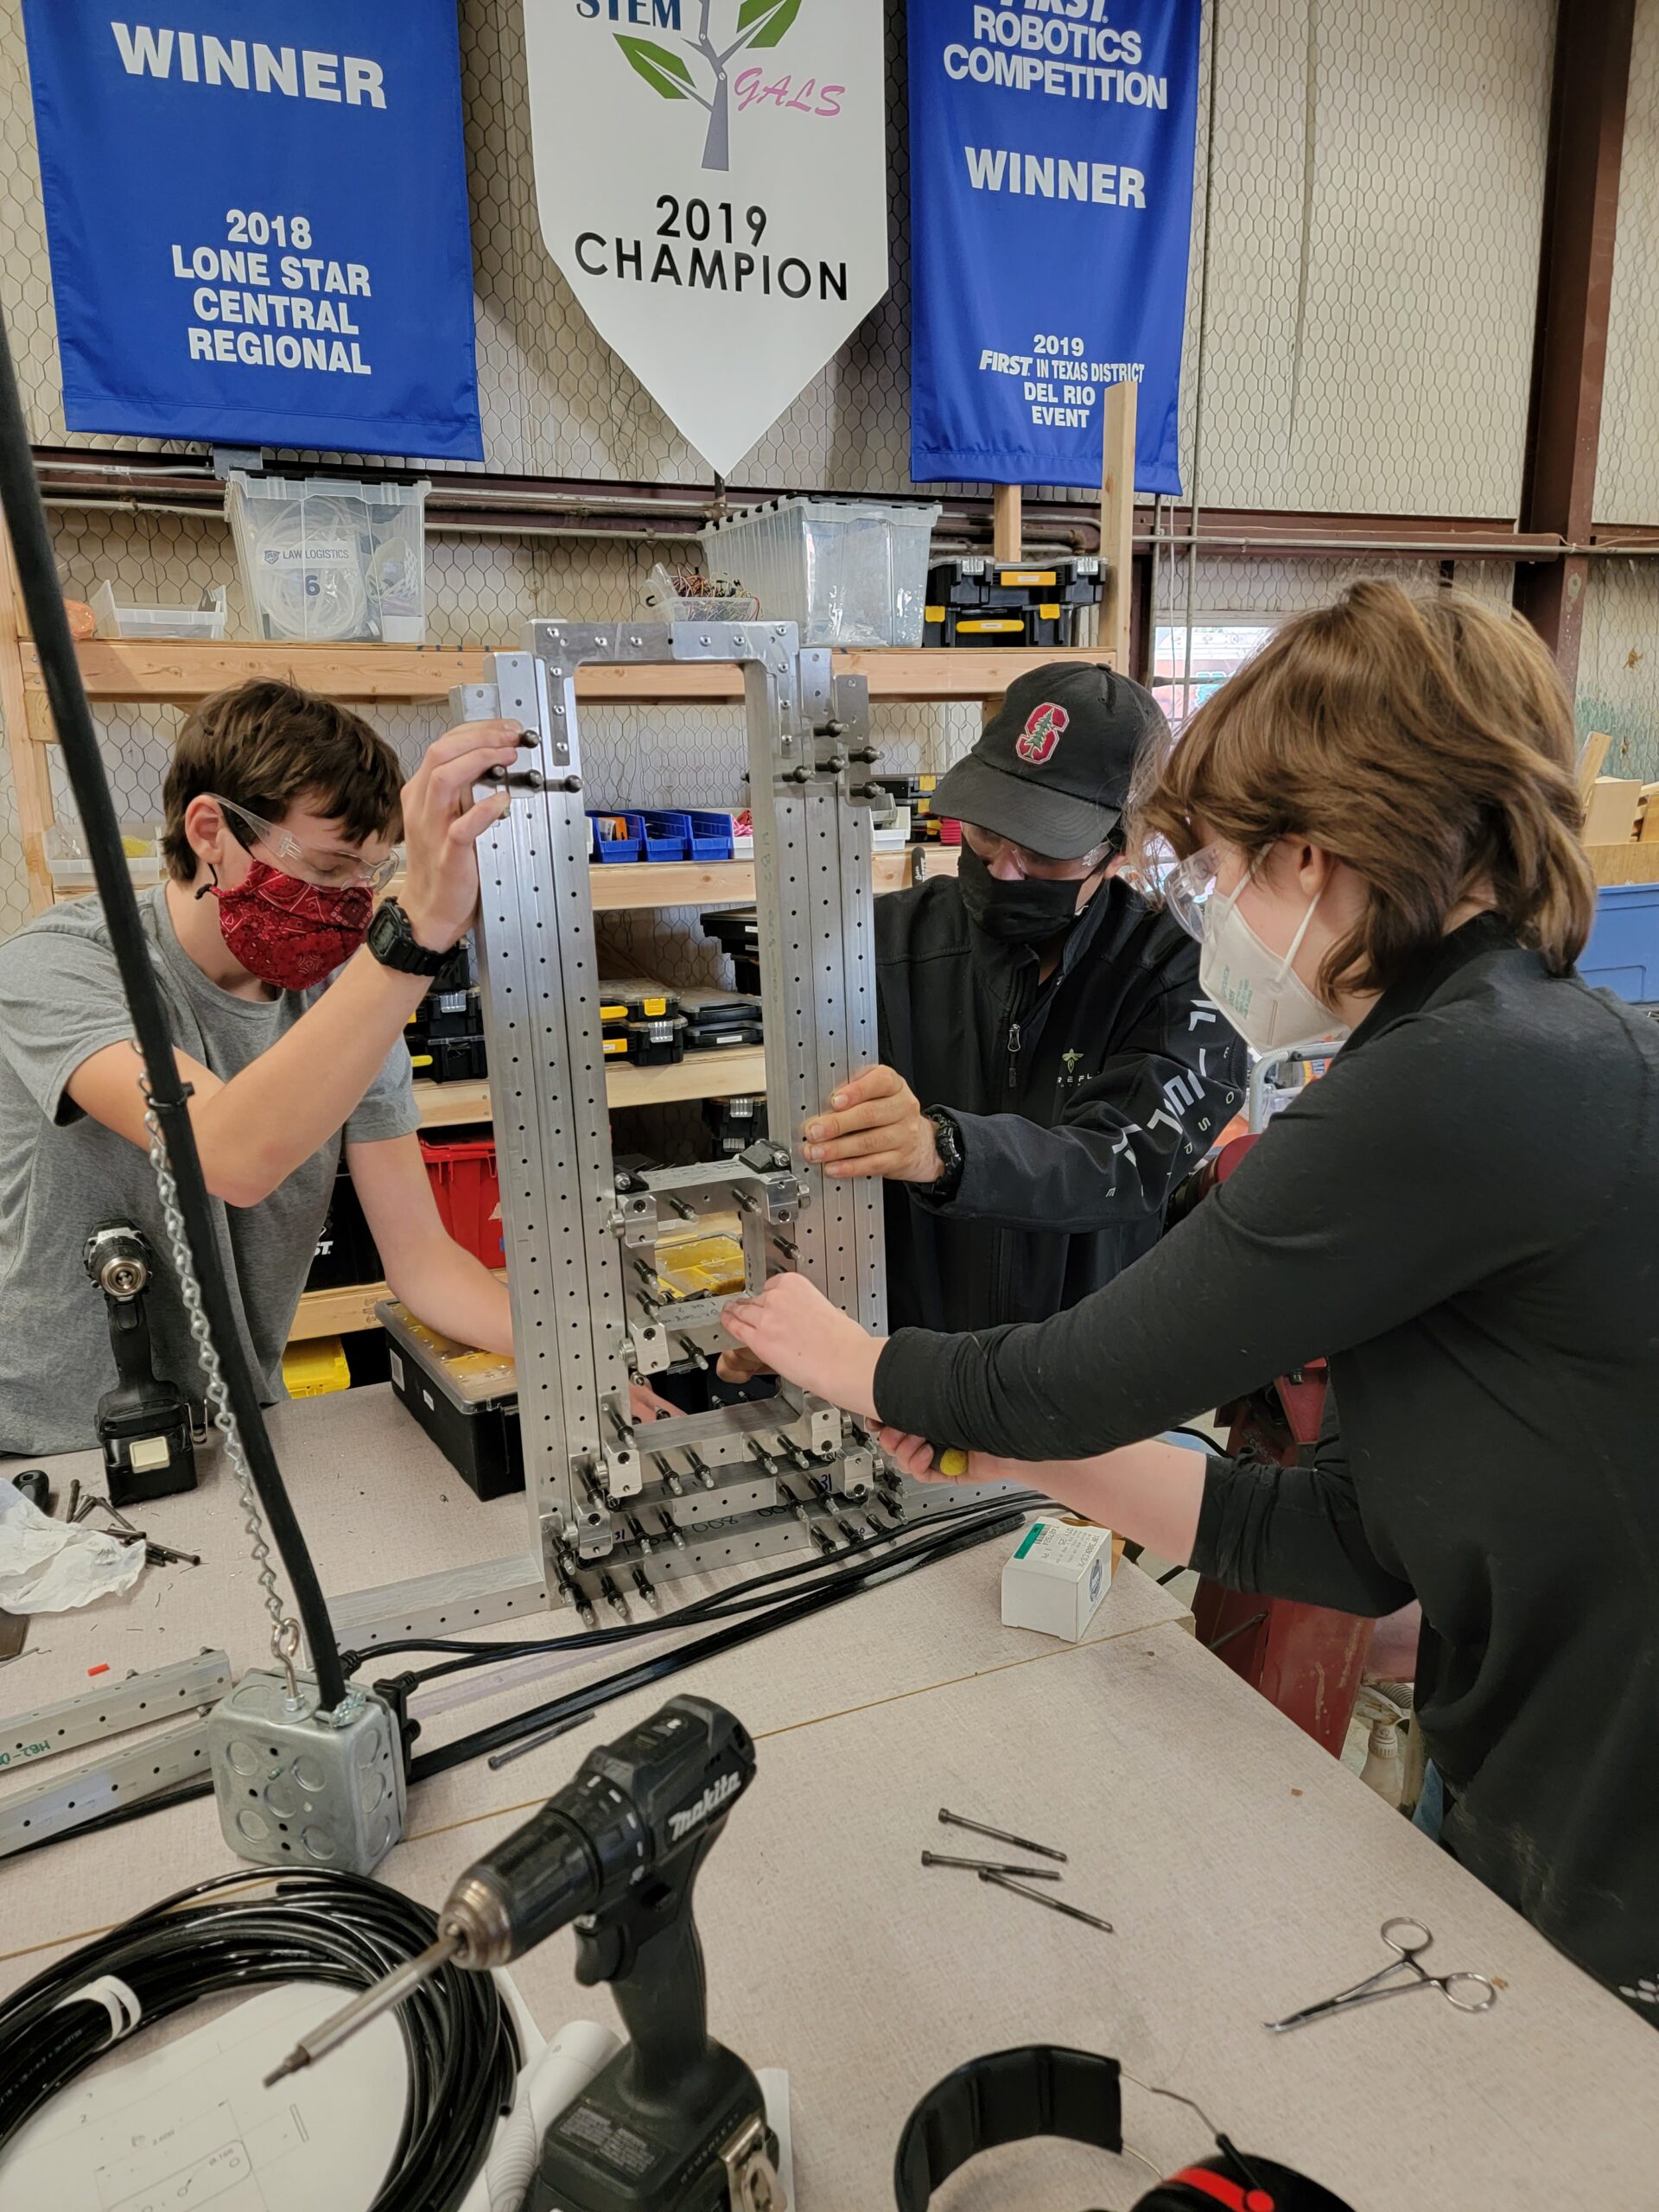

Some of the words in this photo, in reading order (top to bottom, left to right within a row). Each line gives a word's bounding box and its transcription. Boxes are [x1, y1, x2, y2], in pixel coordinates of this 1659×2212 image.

[974, 5, 1142, 65] ROBOTICS
[111, 22, 387, 109] WINNER
[944, 44, 1167, 110] COMPETITION
[734, 67, 845, 117] GALS
[964, 147, 1146, 208] WINNER
[226, 209, 312, 250] 2018
[656, 194, 766, 247] 2019
[172, 245, 270, 286] LONE
[281, 256, 372, 297] STAR
[575, 232, 848, 301] CHAMPION
[193, 288, 359, 335] CENTRAL
[188, 327, 372, 375] REGIONAL
[1033, 334, 1084, 356] 2019
[1024, 382, 1058, 403] DEL
[1064, 385, 1096, 406] RIO
[1037, 359, 1049, 378] IN
[1052, 360, 1088, 382] TEXAS
[1090, 363, 1145, 383] DISTRICT
[1032, 405, 1090, 428] EVENT
[283, 550, 302, 559] LAW
[305, 550, 349, 559] LOGISTICS
[305, 575, 320, 596] 6
